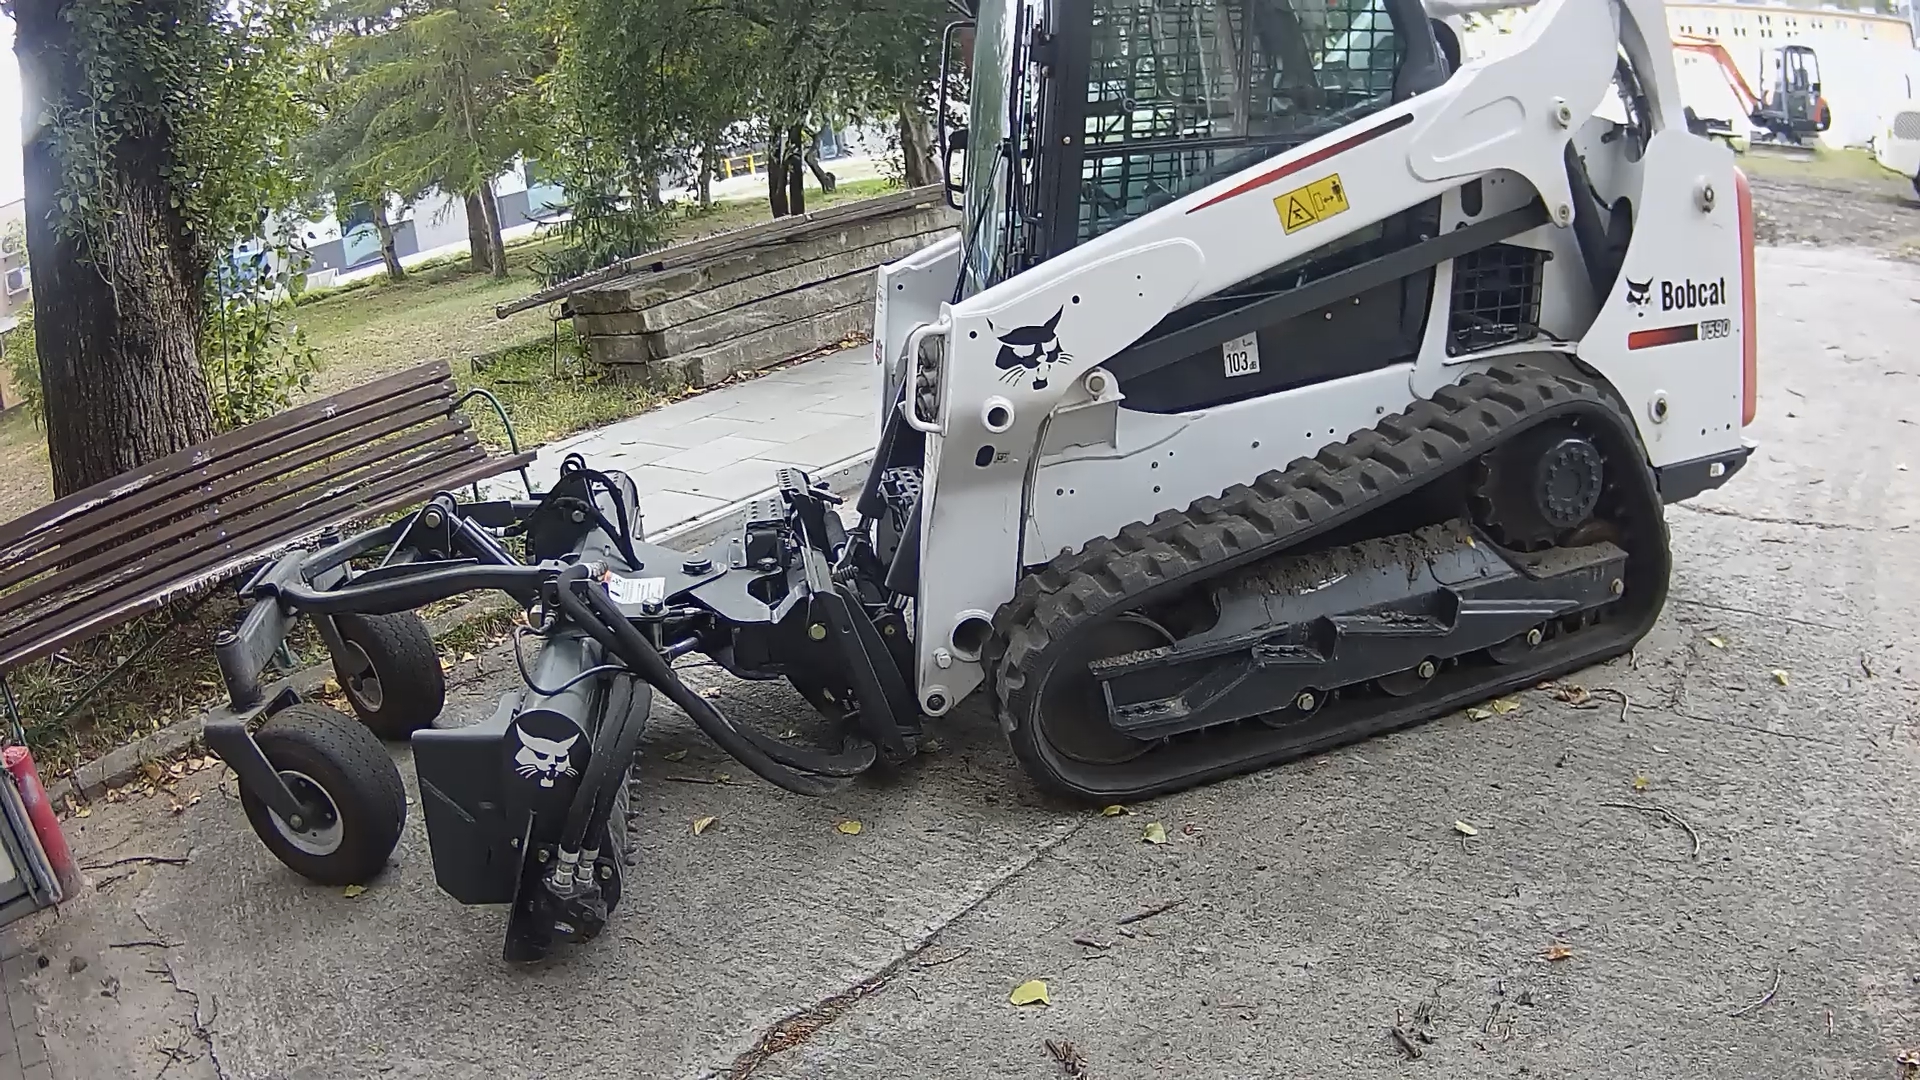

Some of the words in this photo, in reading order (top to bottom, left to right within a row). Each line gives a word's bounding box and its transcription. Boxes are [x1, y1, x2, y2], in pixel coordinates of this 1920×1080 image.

[1661, 276, 1725, 311] Bobcat
[1701, 318, 1730, 340] T590
[1226, 351, 1248, 374] 103
